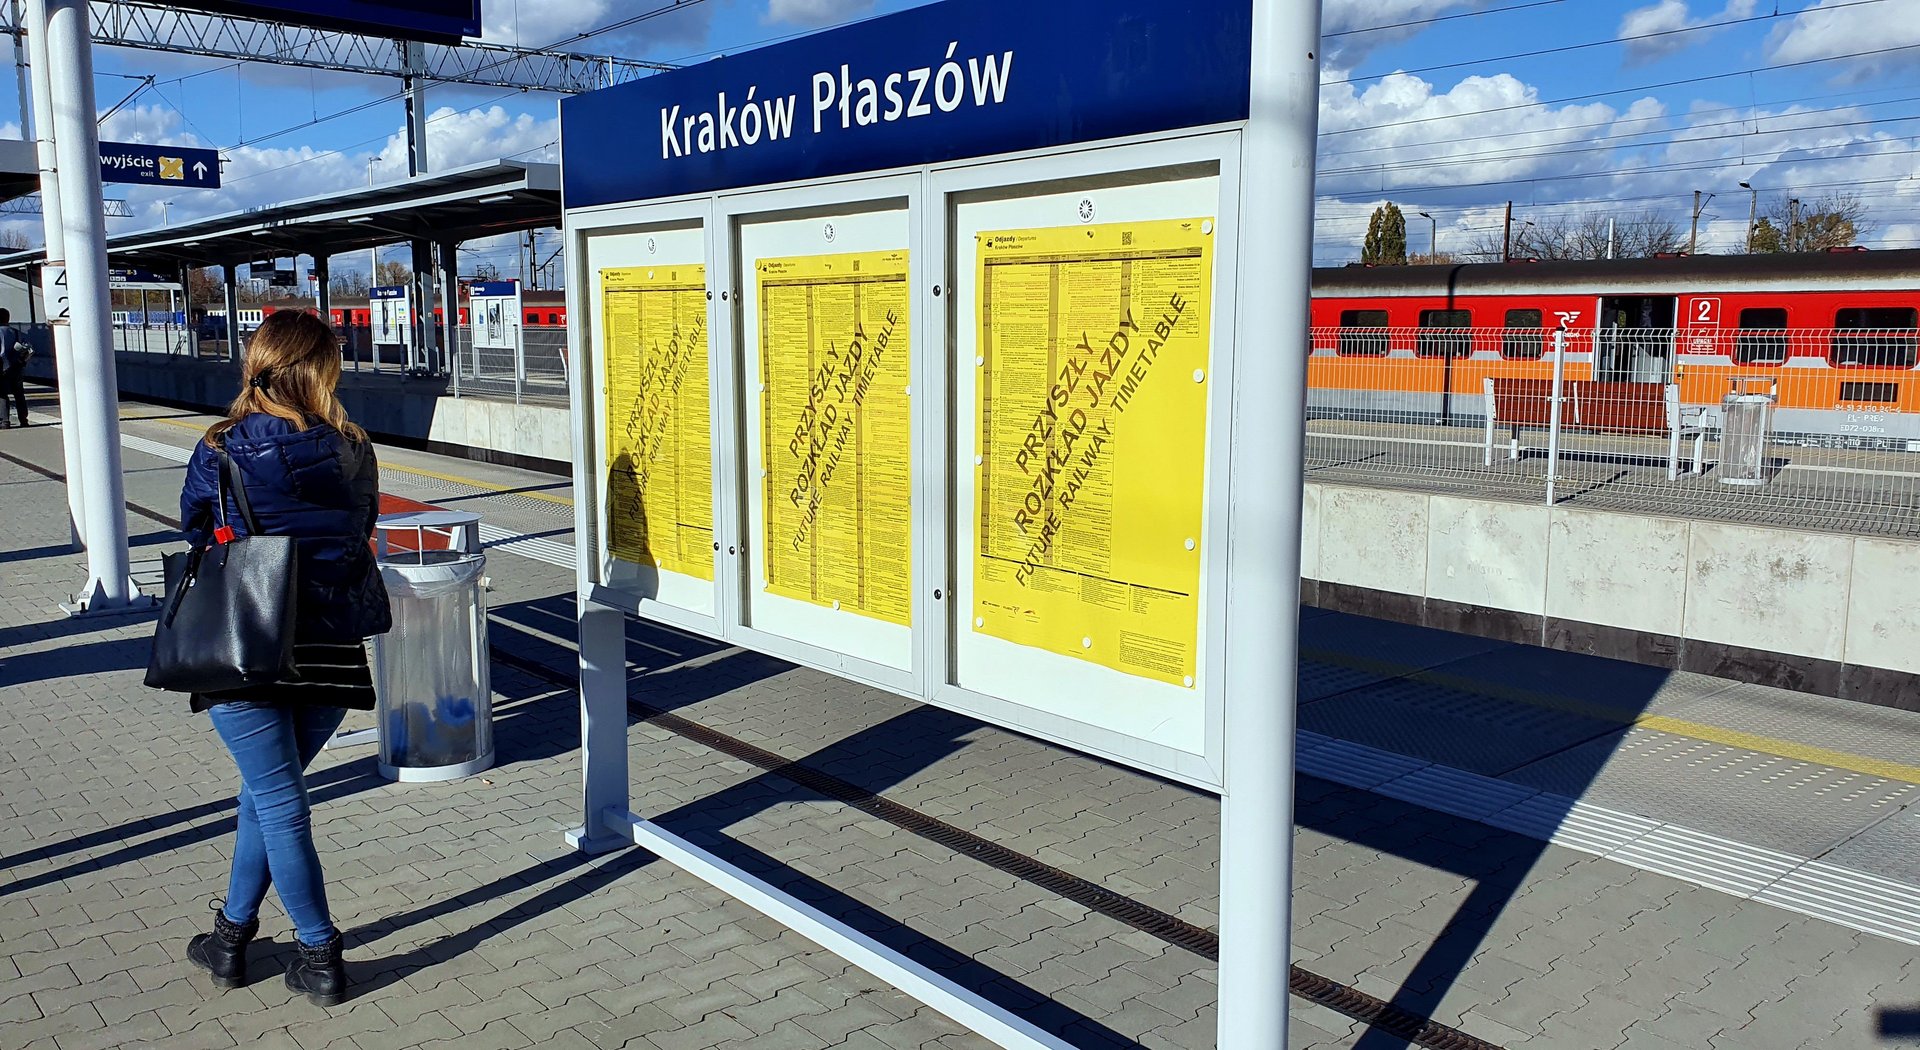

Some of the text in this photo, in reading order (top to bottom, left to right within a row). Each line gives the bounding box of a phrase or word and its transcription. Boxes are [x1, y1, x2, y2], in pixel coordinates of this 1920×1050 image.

[99, 154, 154, 169] wyjście
[661, 41, 1014, 159] Kraków Płaszów
[54, 269, 69, 291] 4
[57, 296, 70, 318] 2
[1697, 300, 1711, 321] 2
[626, 339, 661, 440] PRZYSZŁY
[627, 324, 682, 483] ROZKŁAD JAZDY
[648, 400, 672, 464] RAILWAY
[671, 313, 704, 395] TIMETABLE
[789, 340, 839, 458] PRZYSZŁY
[790, 322, 868, 508] ROZKŁAD JAZDY
[792, 309, 898, 552] FUTURE RAILWAY TIMETABLE
[1014, 408, 1087, 534] ROZKŁAD
[1086, 307, 1139, 408] JAZDY
[1015, 331, 1094, 475] PRZYSZŁY
[1015, 512, 1061, 587] FUTURE
[1059, 417, 1112, 510] RAILWAY
[1110, 292, 1188, 413] TIMETABLE
